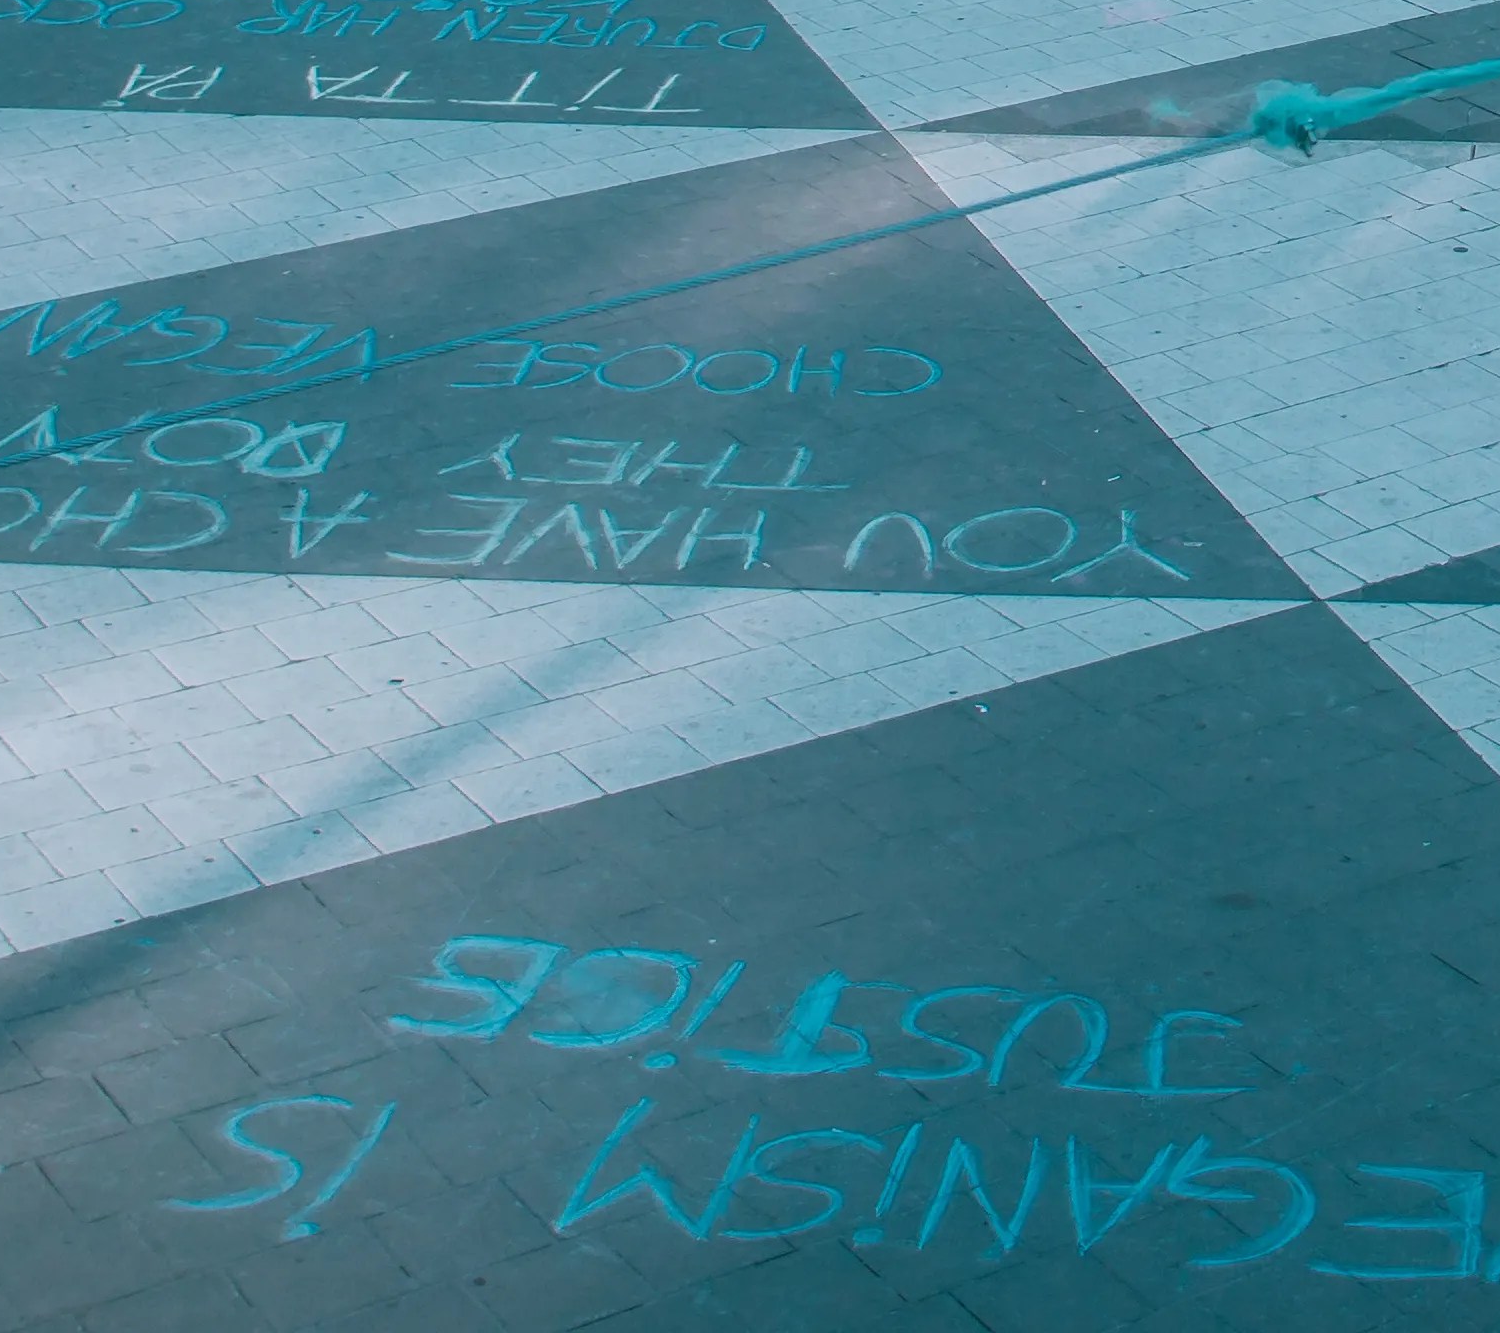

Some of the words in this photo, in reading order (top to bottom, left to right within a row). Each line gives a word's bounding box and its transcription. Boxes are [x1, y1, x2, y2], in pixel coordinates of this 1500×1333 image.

[432, 7, 768, 50] DJUREN
[102, 62, 224, 109] PÅ
[303, 63, 703, 114] TITTA
[449, 341, 945, 396] CHOOSE
[436, 431, 854, 493] THEY
[280, 484, 371, 559] A
[385, 494, 770, 570] HAVE
[844, 507, 1211, 583] YOU
[385, 933, 1263, 1097] JUSTICE
[165, 1091, 396, 1239] IS
